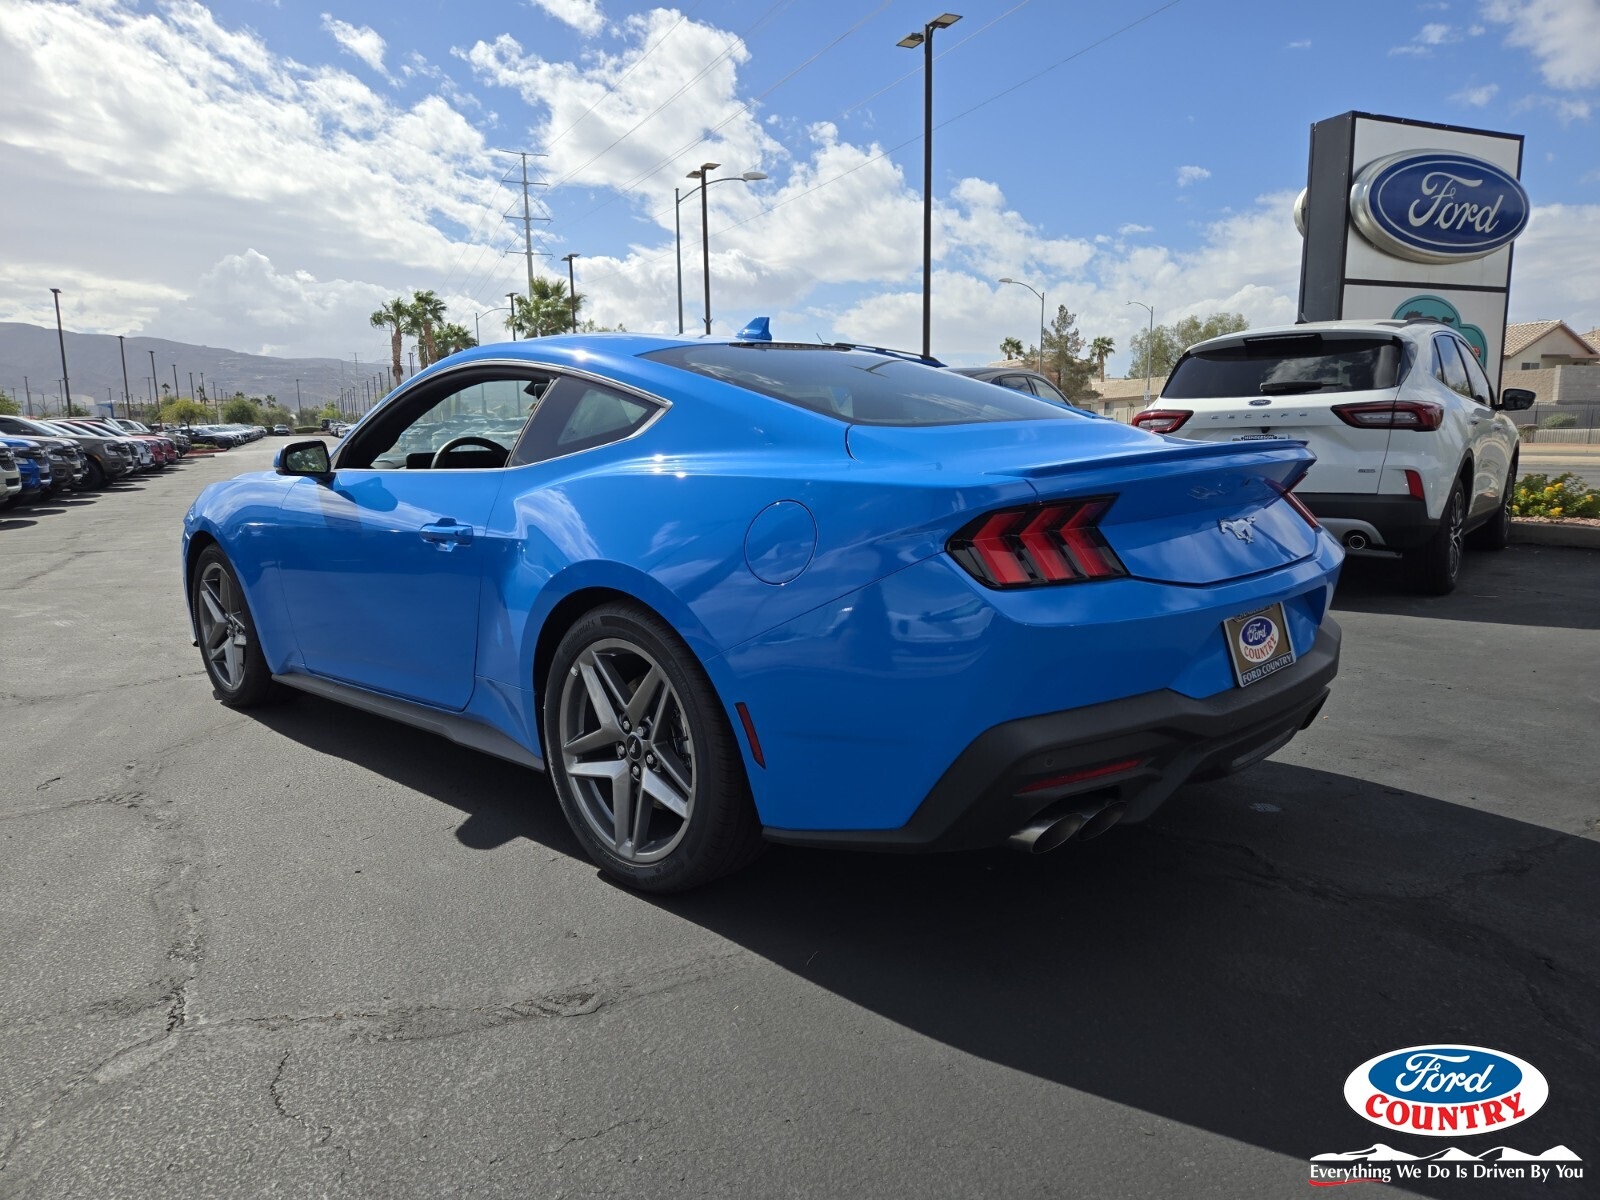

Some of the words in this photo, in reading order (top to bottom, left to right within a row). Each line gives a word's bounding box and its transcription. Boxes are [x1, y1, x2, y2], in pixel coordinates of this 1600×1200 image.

[1408, 171, 1504, 233] Ford
[1247, 622, 1267, 642] Ford
[1244, 634, 1277, 659] COUNTRY
[1242, 668, 1262, 684] FORD
[1261, 654, 1292, 674] COUNTRY
